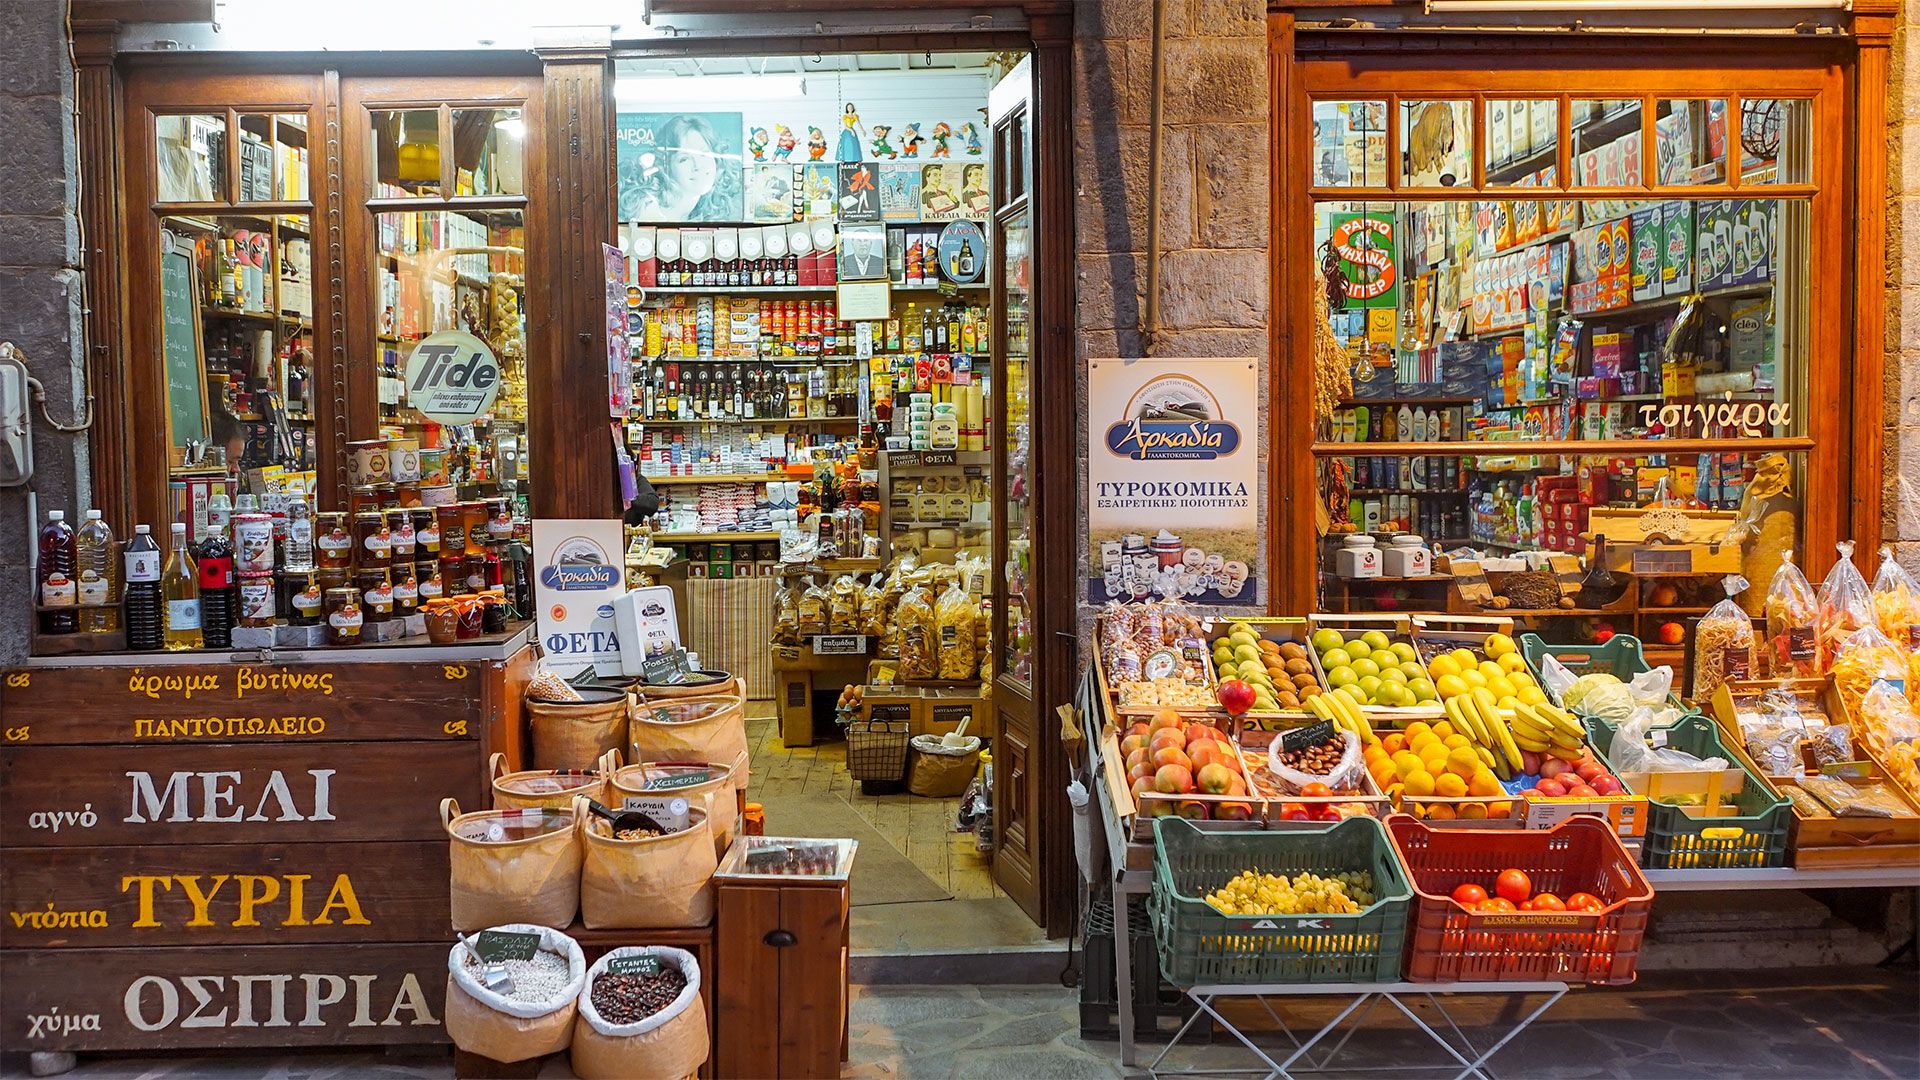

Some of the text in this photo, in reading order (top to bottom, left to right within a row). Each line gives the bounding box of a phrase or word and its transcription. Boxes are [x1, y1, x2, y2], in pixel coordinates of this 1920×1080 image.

[411, 345, 498, 394] Tide
[1638, 390, 1791, 439] τσιγάρα
[925, 455, 954, 464] ΦΕΤΑ
[1096, 481, 1248, 497] ΤΥΡΟΚΟΜΙΚΑ
[1097, 499, 1248, 508] ΕΞΑΙΡΕΤΙΚΗΣ ΠΟΙΟΤΗΤΑΣ
[546, 631, 621, 654] ΦΕΤΑ
[648, 630, 667, 638] ΦΕΤΑ
[823, 639, 855, 647] παξιμάδια
[129, 667, 334, 699] άρωμα βυτίνας
[134, 717, 326, 738] ΠΑΝΤΟΠΩΛΕΙΟ
[123, 768, 337, 824] ΜΕΛΙ
[630, 801, 665, 810] ΚΑΡΥΔΙΑ
[28, 803, 99, 833] αγνό
[122, 873, 371, 928] ΤΥΡΙΑ
[11, 902, 109, 930] ντόπια
[481, 932, 535, 945] ΦΑΣΟΛΙΑ
[124, 973, 441, 1033] ΟΣΠΡΙΑ
[26, 1006, 101, 1039] χύμα
